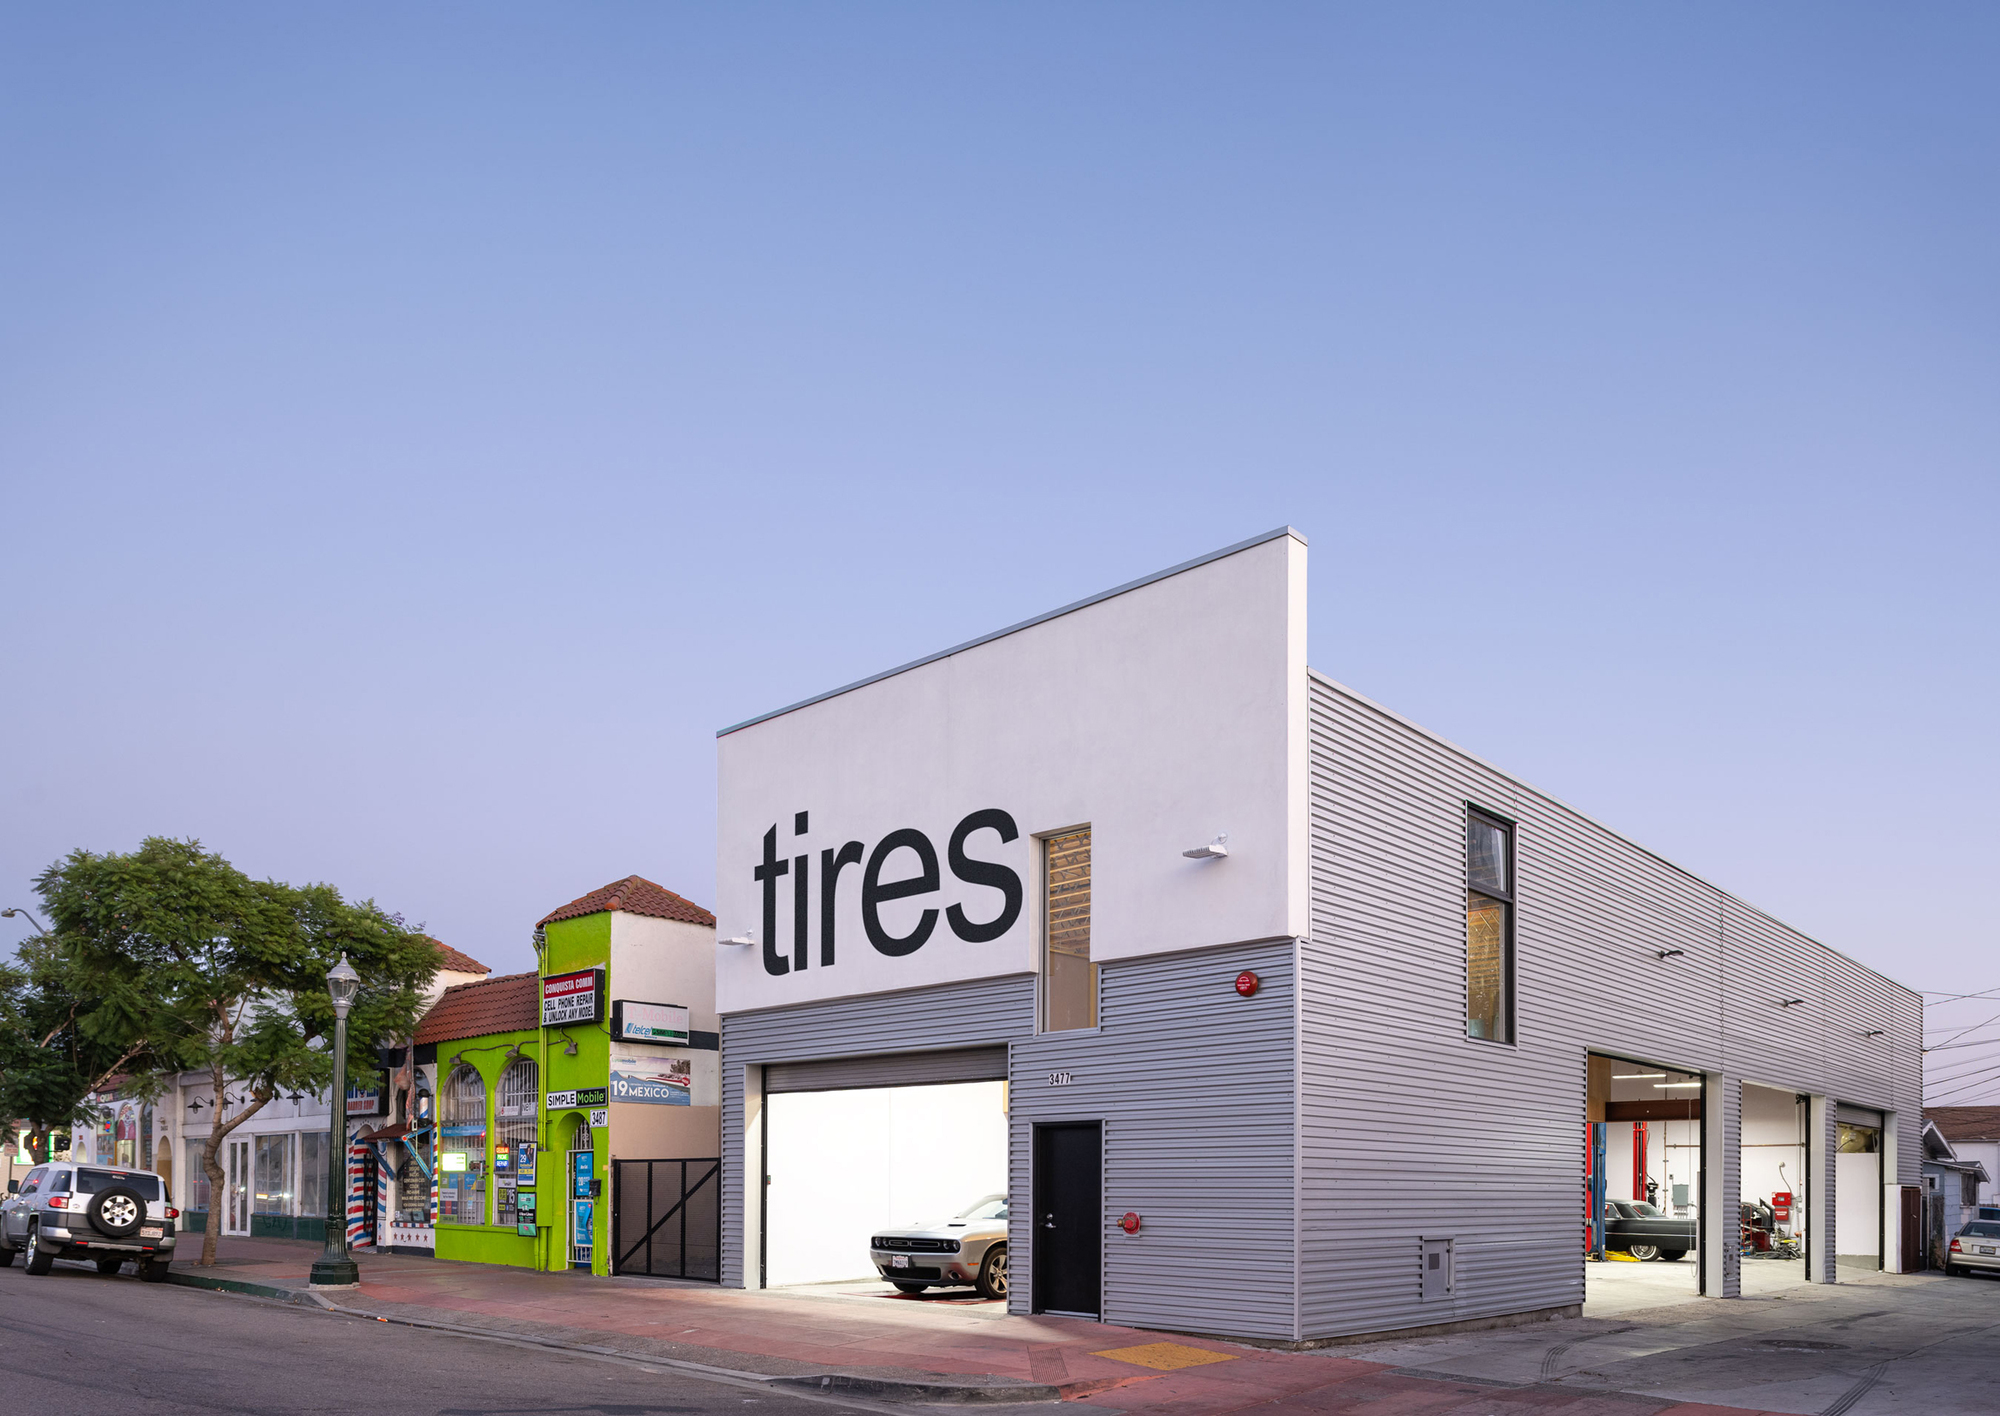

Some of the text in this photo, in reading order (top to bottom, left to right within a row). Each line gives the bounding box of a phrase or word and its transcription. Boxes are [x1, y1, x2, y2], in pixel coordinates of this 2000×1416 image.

[754, 808, 1023, 976] tires
[545, 976, 593, 995] CONQUISTA COMM
[544, 993, 593, 1011] CELL PHONE REPAIR
[543, 1005, 593, 1023] & UNLOCK ANY MODEL
[627, 1006, 683, 1024] T-Mobile
[632, 1025, 653, 1036] telcel
[1049, 1072, 1070, 1085] 3477
[548, 1091, 604, 1106] SIMPLE Mobile
[628, 1086, 670, 1099] MEXICO
[592, 1111, 606, 1125] 3487
